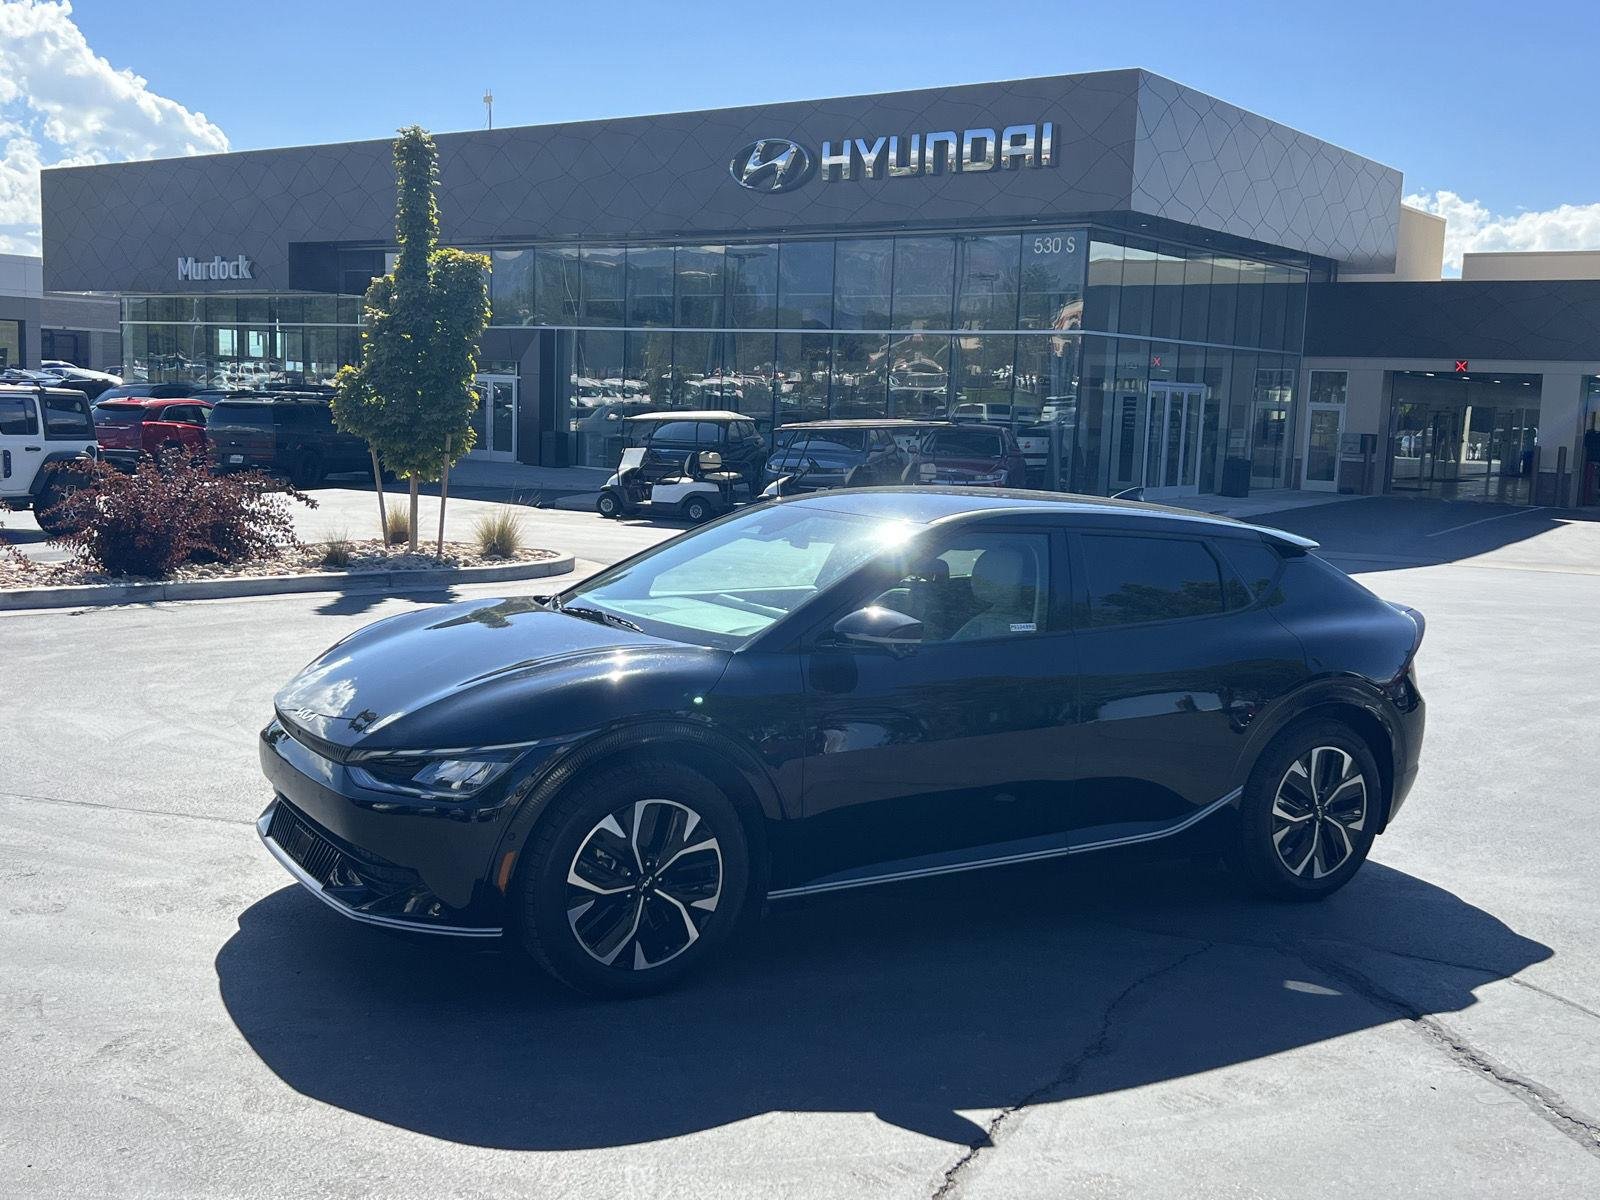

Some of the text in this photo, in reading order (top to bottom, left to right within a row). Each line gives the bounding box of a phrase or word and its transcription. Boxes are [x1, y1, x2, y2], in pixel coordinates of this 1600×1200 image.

[821, 122, 1054, 181] HYUNDAI
[1034, 236, 1076, 254] 530 S
[177, 254, 253, 281] Murdock
